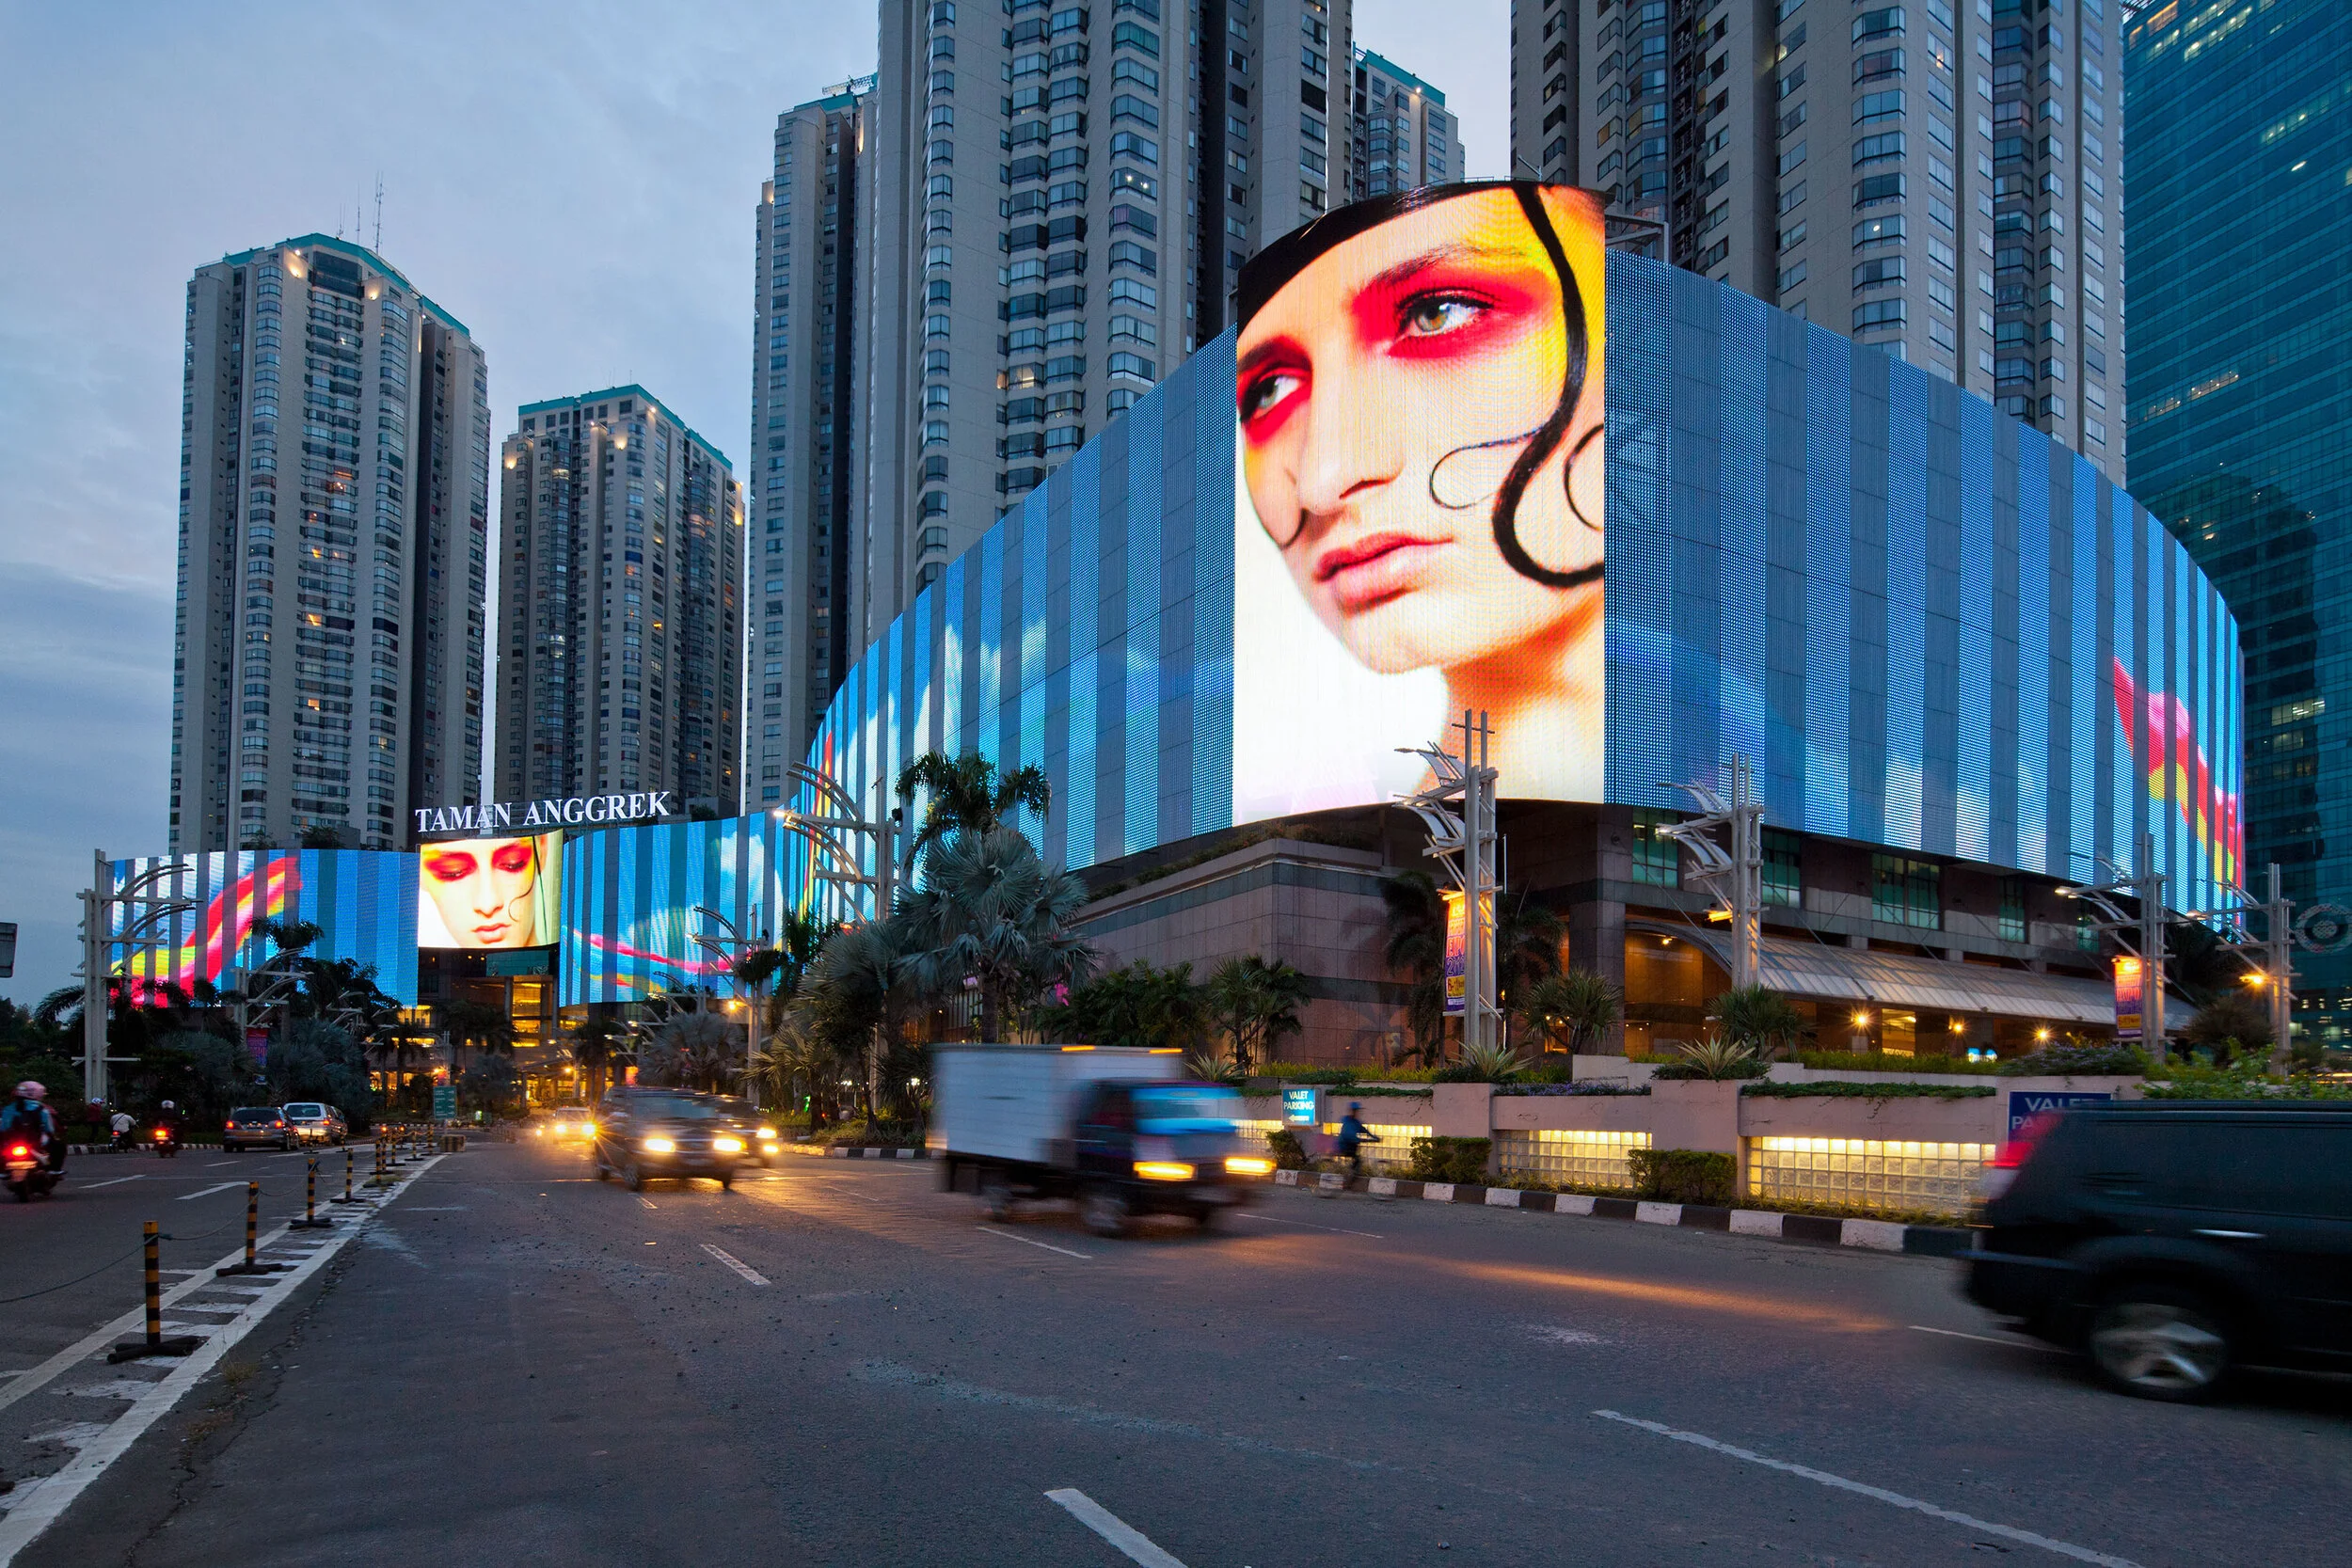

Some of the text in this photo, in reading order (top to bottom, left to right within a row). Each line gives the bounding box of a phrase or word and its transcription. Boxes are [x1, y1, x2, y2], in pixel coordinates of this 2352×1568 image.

[415, 791, 670, 832] TAMAN ANGGREK
[1289, 1091, 1309, 1100] VALET
[1283, 1101, 1314, 1110] PARKING
